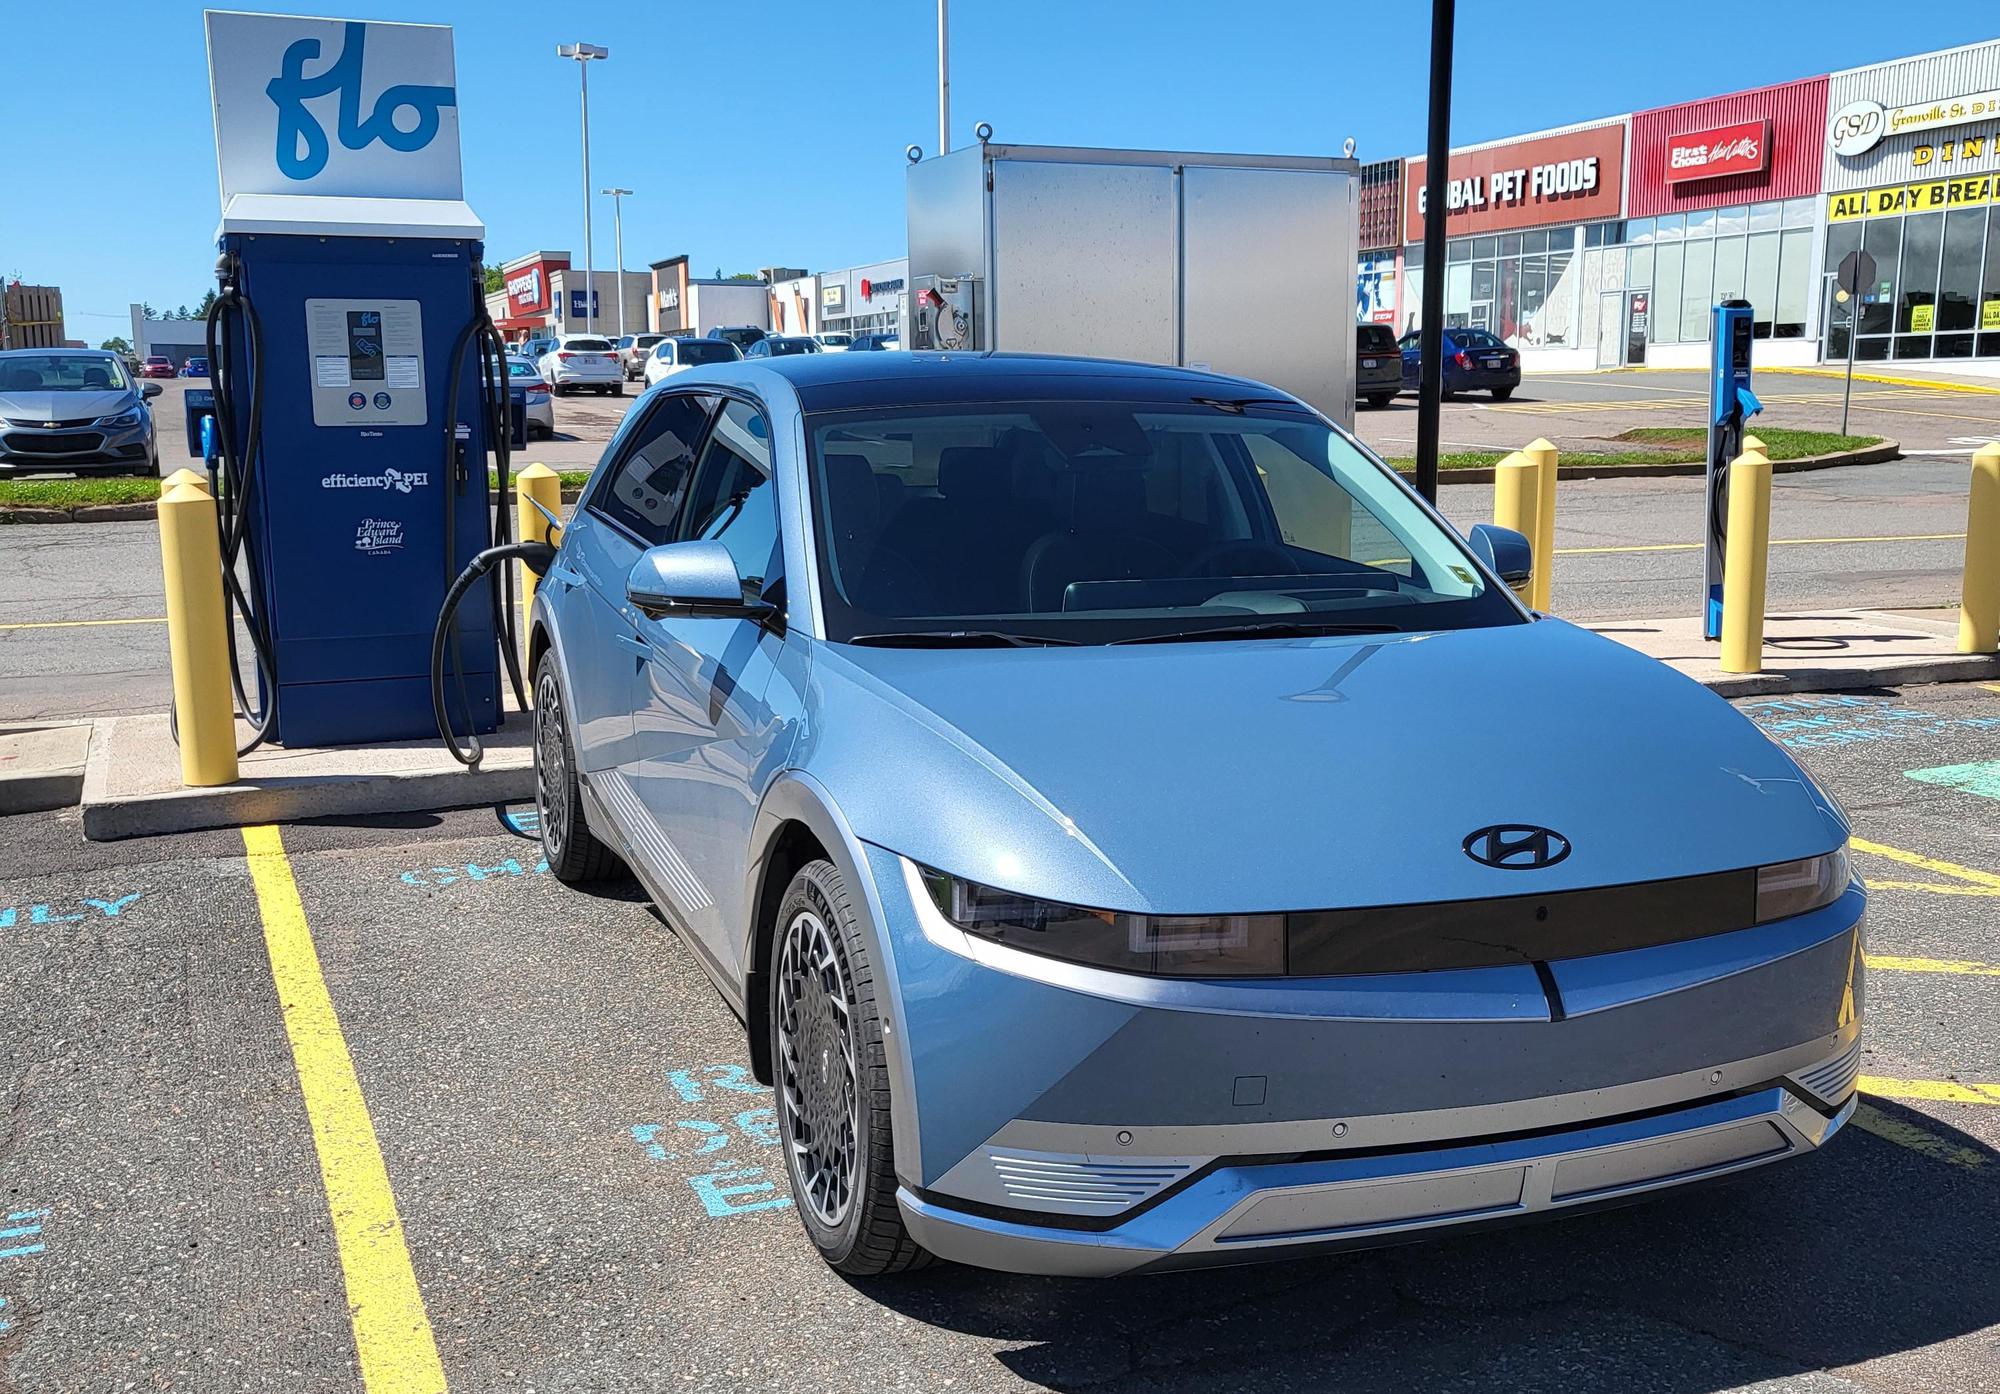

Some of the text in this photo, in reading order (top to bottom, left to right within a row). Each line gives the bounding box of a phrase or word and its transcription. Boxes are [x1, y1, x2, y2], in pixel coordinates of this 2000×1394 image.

[266, 22, 456, 180] flo
[1833, 111, 1880, 149] GSD
[1892, 104, 1948, 132] Granville
[1950, 103, 1967, 120] St.
[1417, 156, 1598, 215] GBAL PET FOODS
[1834, 196, 1872, 218] ALL
[1878, 188, 1922, 213] DAY
[361, 311, 379, 326] flo
[321, 472, 429, 490] efficiency PEI
[356, 526, 399, 538] Edward
[361, 517, 402, 529] Prince
[372, 532, 404, 548] Island
[815, 891, 854, 997] MICHELIN
